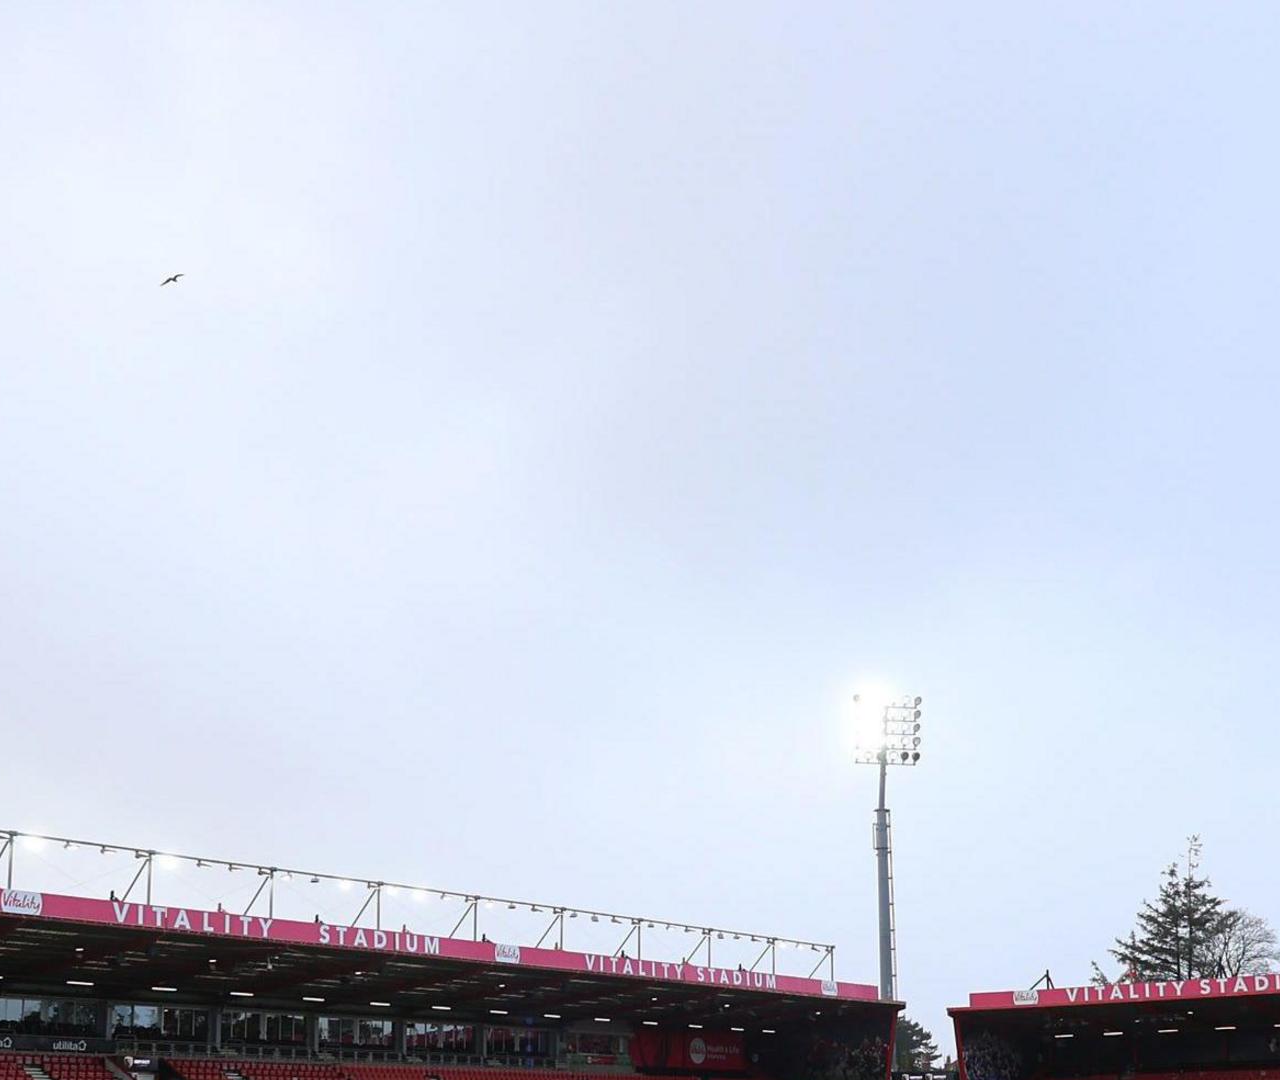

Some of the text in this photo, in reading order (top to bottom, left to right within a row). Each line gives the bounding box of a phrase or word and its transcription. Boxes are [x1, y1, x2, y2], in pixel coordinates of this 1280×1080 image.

[4, 891, 40, 914] Vitality
[113, 902, 440, 954] VITALITY STADIUM
[585, 955, 776, 989] VITALITY STADIUM
[1066, 982, 1185, 1002] VITALITY
[53, 1040, 79, 1051] utilita
